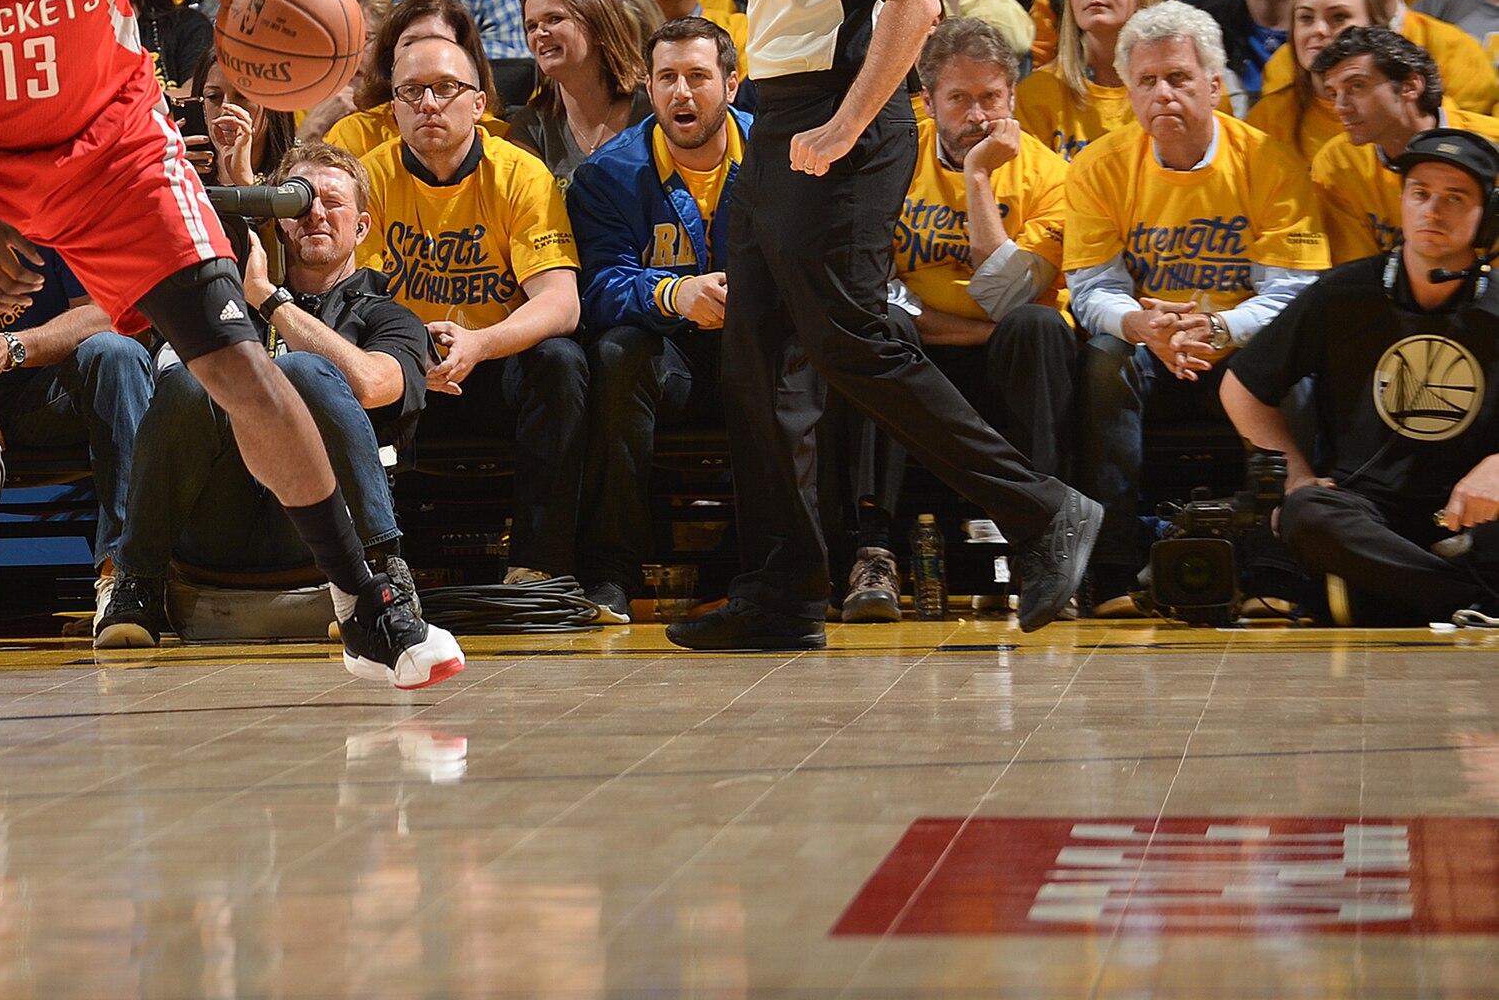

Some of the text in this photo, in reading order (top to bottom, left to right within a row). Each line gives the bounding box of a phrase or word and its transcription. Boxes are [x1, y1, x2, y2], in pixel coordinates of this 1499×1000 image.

[386, 221, 489, 277] Strength
[534, 239, 571, 251] EXPRESS
[1125, 215, 1249, 262] trength
[220, 310, 245, 321] adidas
